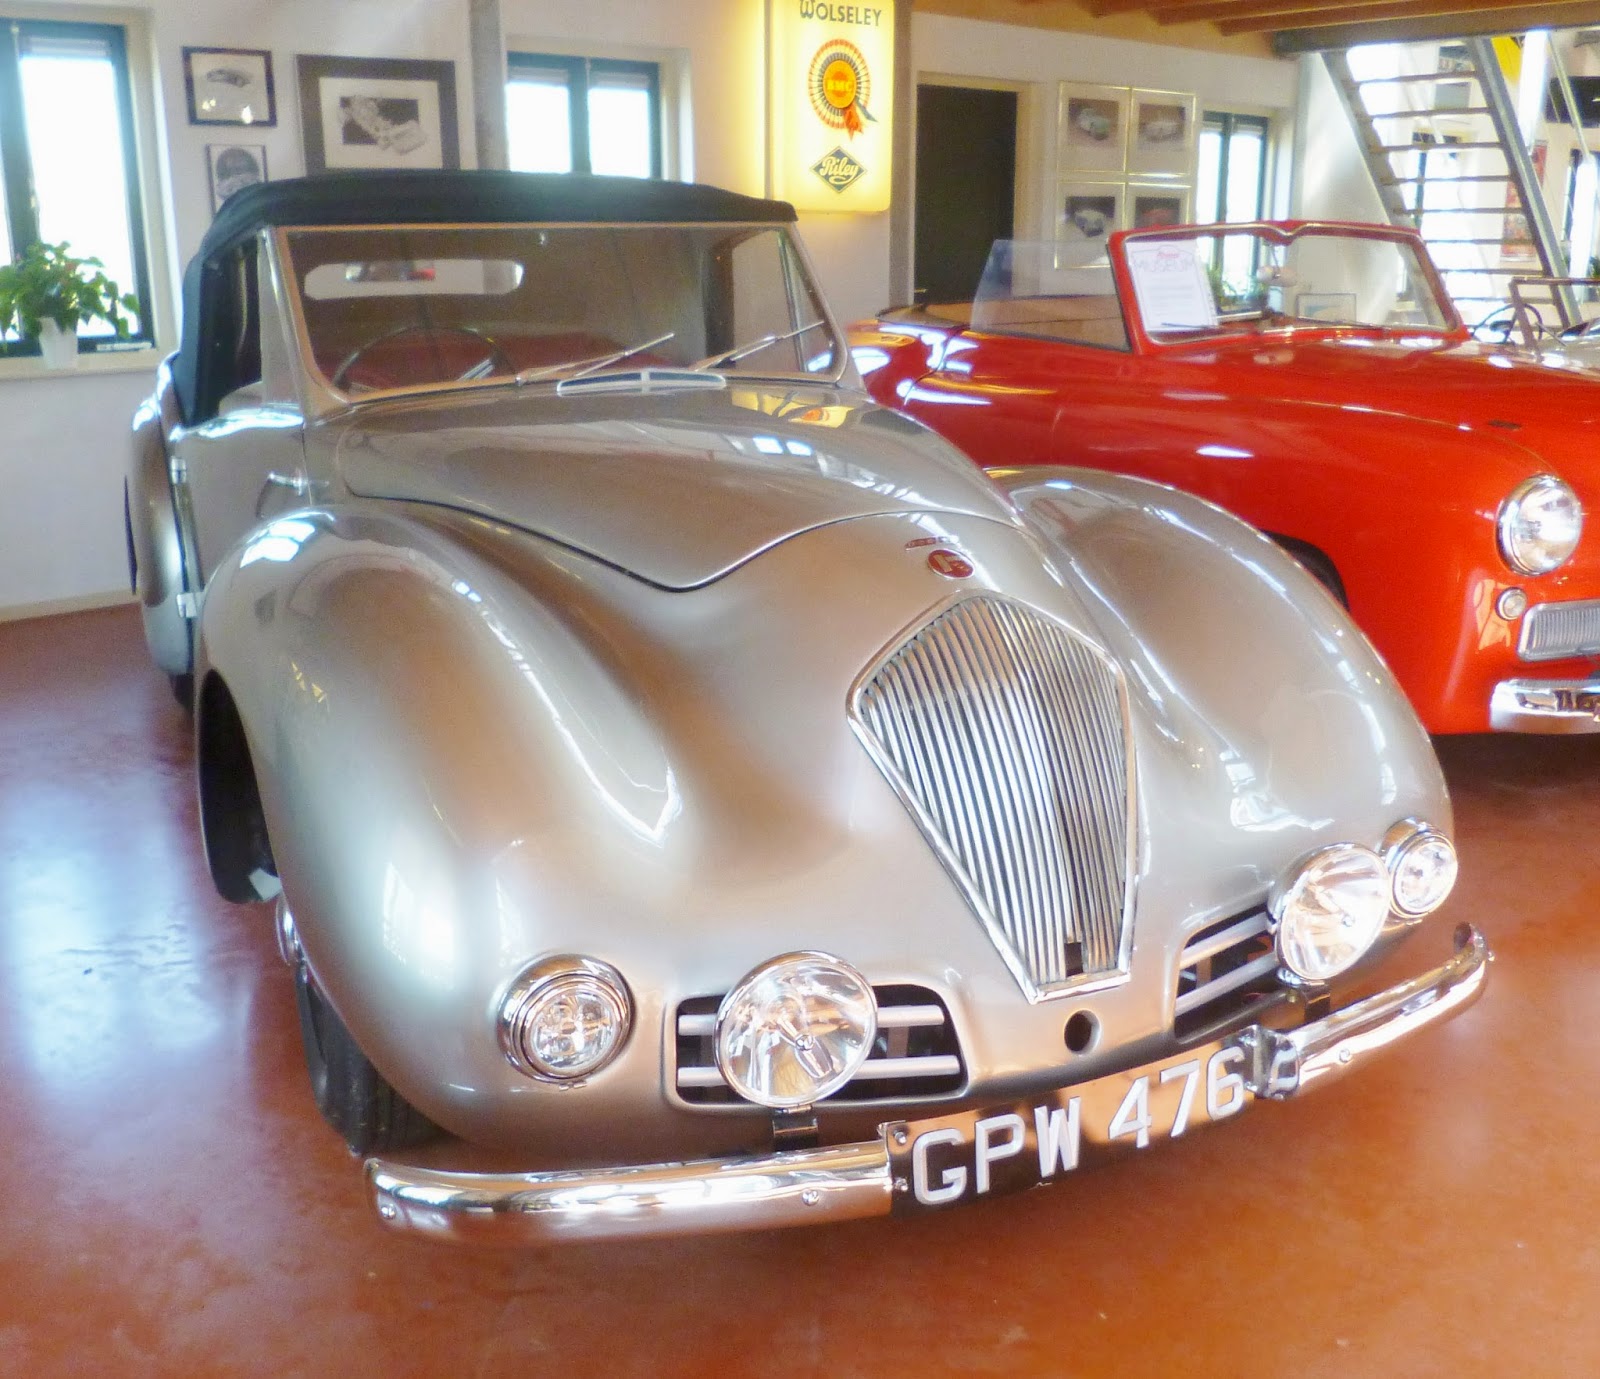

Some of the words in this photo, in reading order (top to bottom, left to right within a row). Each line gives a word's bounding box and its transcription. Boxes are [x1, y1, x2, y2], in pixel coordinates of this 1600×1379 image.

[800, 0, 881, 26] WOLSELEY
[819, 156, 859, 185] Riley
[912, 1095, 1081, 1206] GPW
[1108, 1047, 1246, 1149] 476
